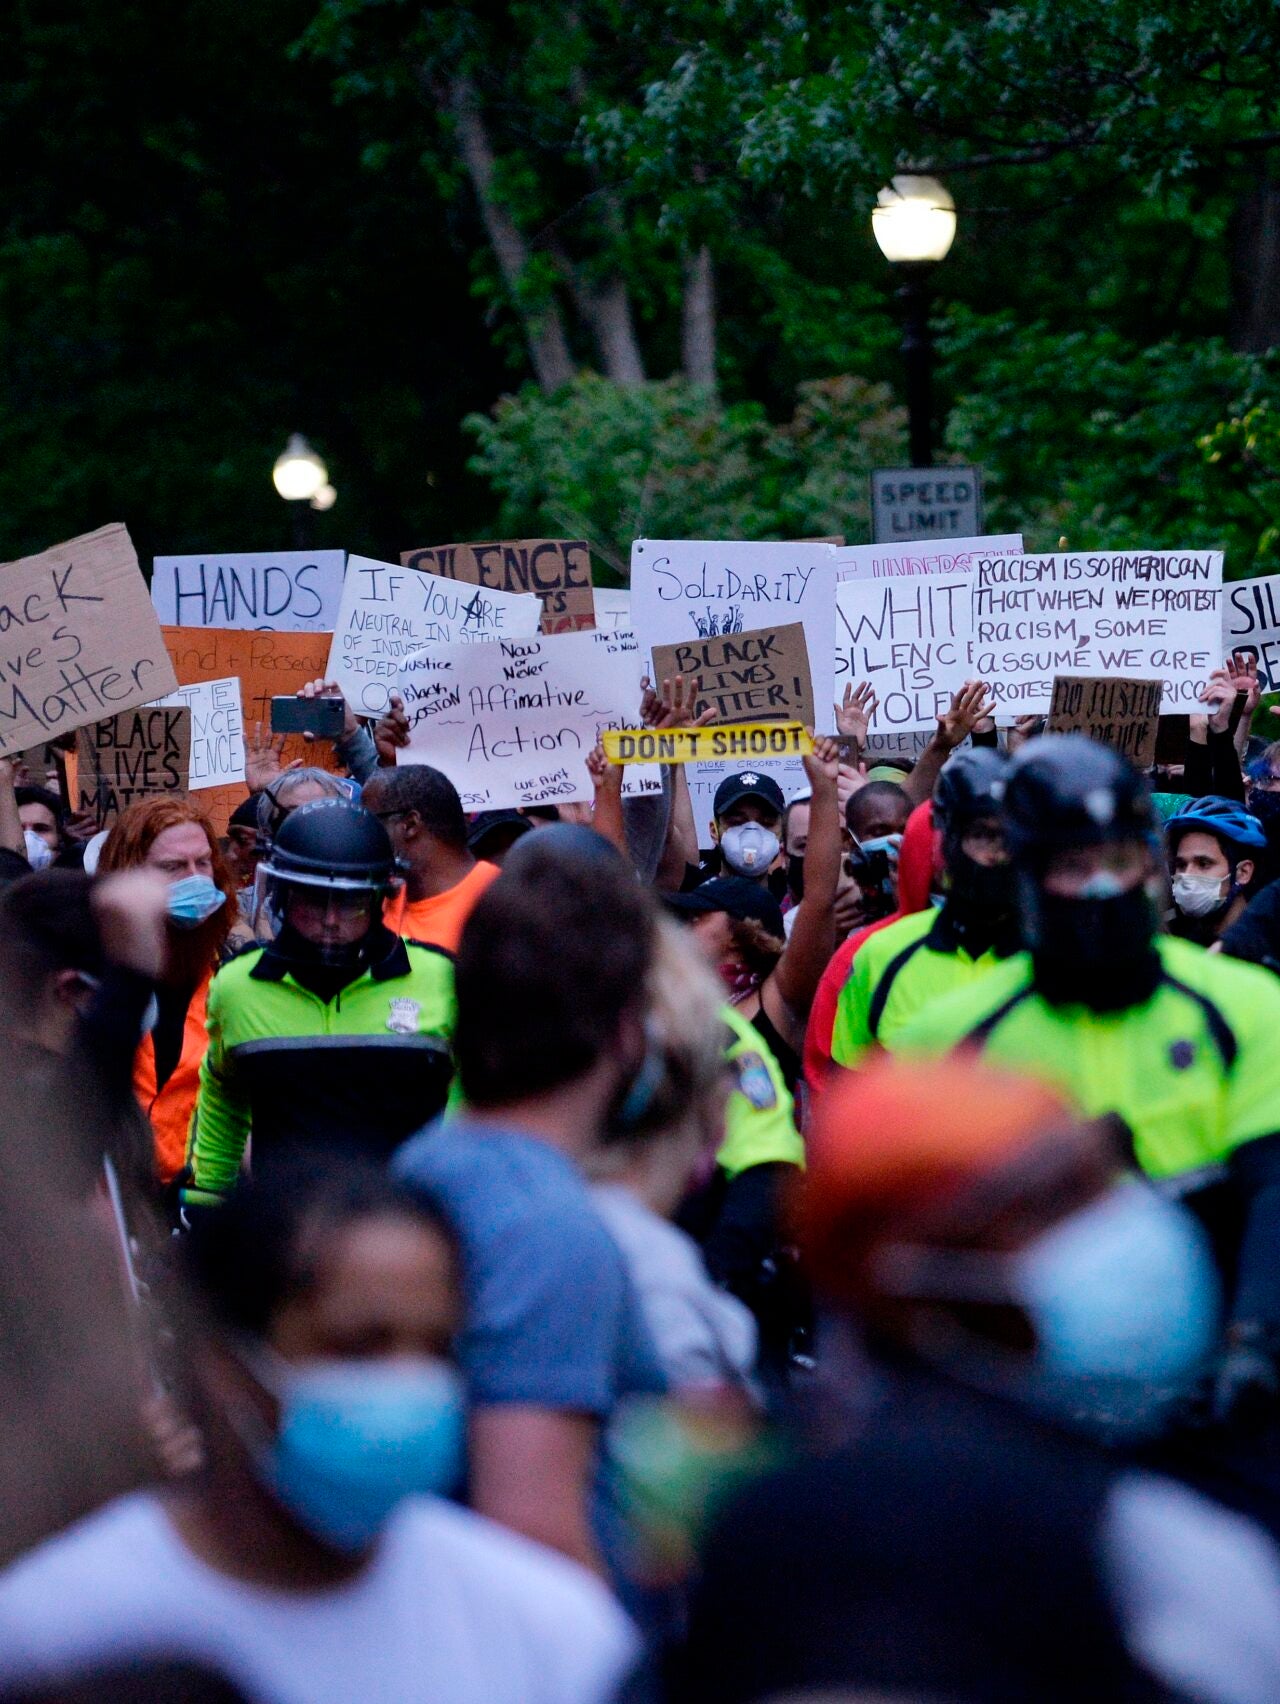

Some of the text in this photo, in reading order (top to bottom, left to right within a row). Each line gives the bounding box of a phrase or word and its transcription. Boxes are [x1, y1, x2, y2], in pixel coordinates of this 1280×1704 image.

[881, 482, 972, 505] SPEED
[892, 510, 960, 533] LIMIT
[1064, 558, 1082, 580] IS
[1085, 558, 1110, 578] SO
[174, 563, 323, 625] HANDS
[359, 568, 404, 601] IF
[417, 575, 459, 620] YOU
[461, 590, 507, 628] ARE
[1037, 587, 1104, 611] WHEN
[1115, 587, 1149, 610] WE
[1152, 588, 1222, 612] PROTEST
[349, 609, 419, 638] NEUTRAL
[425, 622, 450, 643] IN
[836, 583, 975, 643] WHIT
[343, 634, 362, 650] OF
[1095, 619, 1167, 638] SOME
[399, 657, 454, 673] Justice
[675, 635, 784, 673] BLACK
[1098, 649, 1143, 669] WE
[503, 661, 549, 681] Never
[697, 663, 776, 692] LIVES
[900, 667, 934, 692] IS
[96, 709, 183, 752] BLACK
[467, 723, 581, 762] Action
[618, 727, 803, 759] DON'T SHOOT
[95, 750, 181, 789] LIVES
